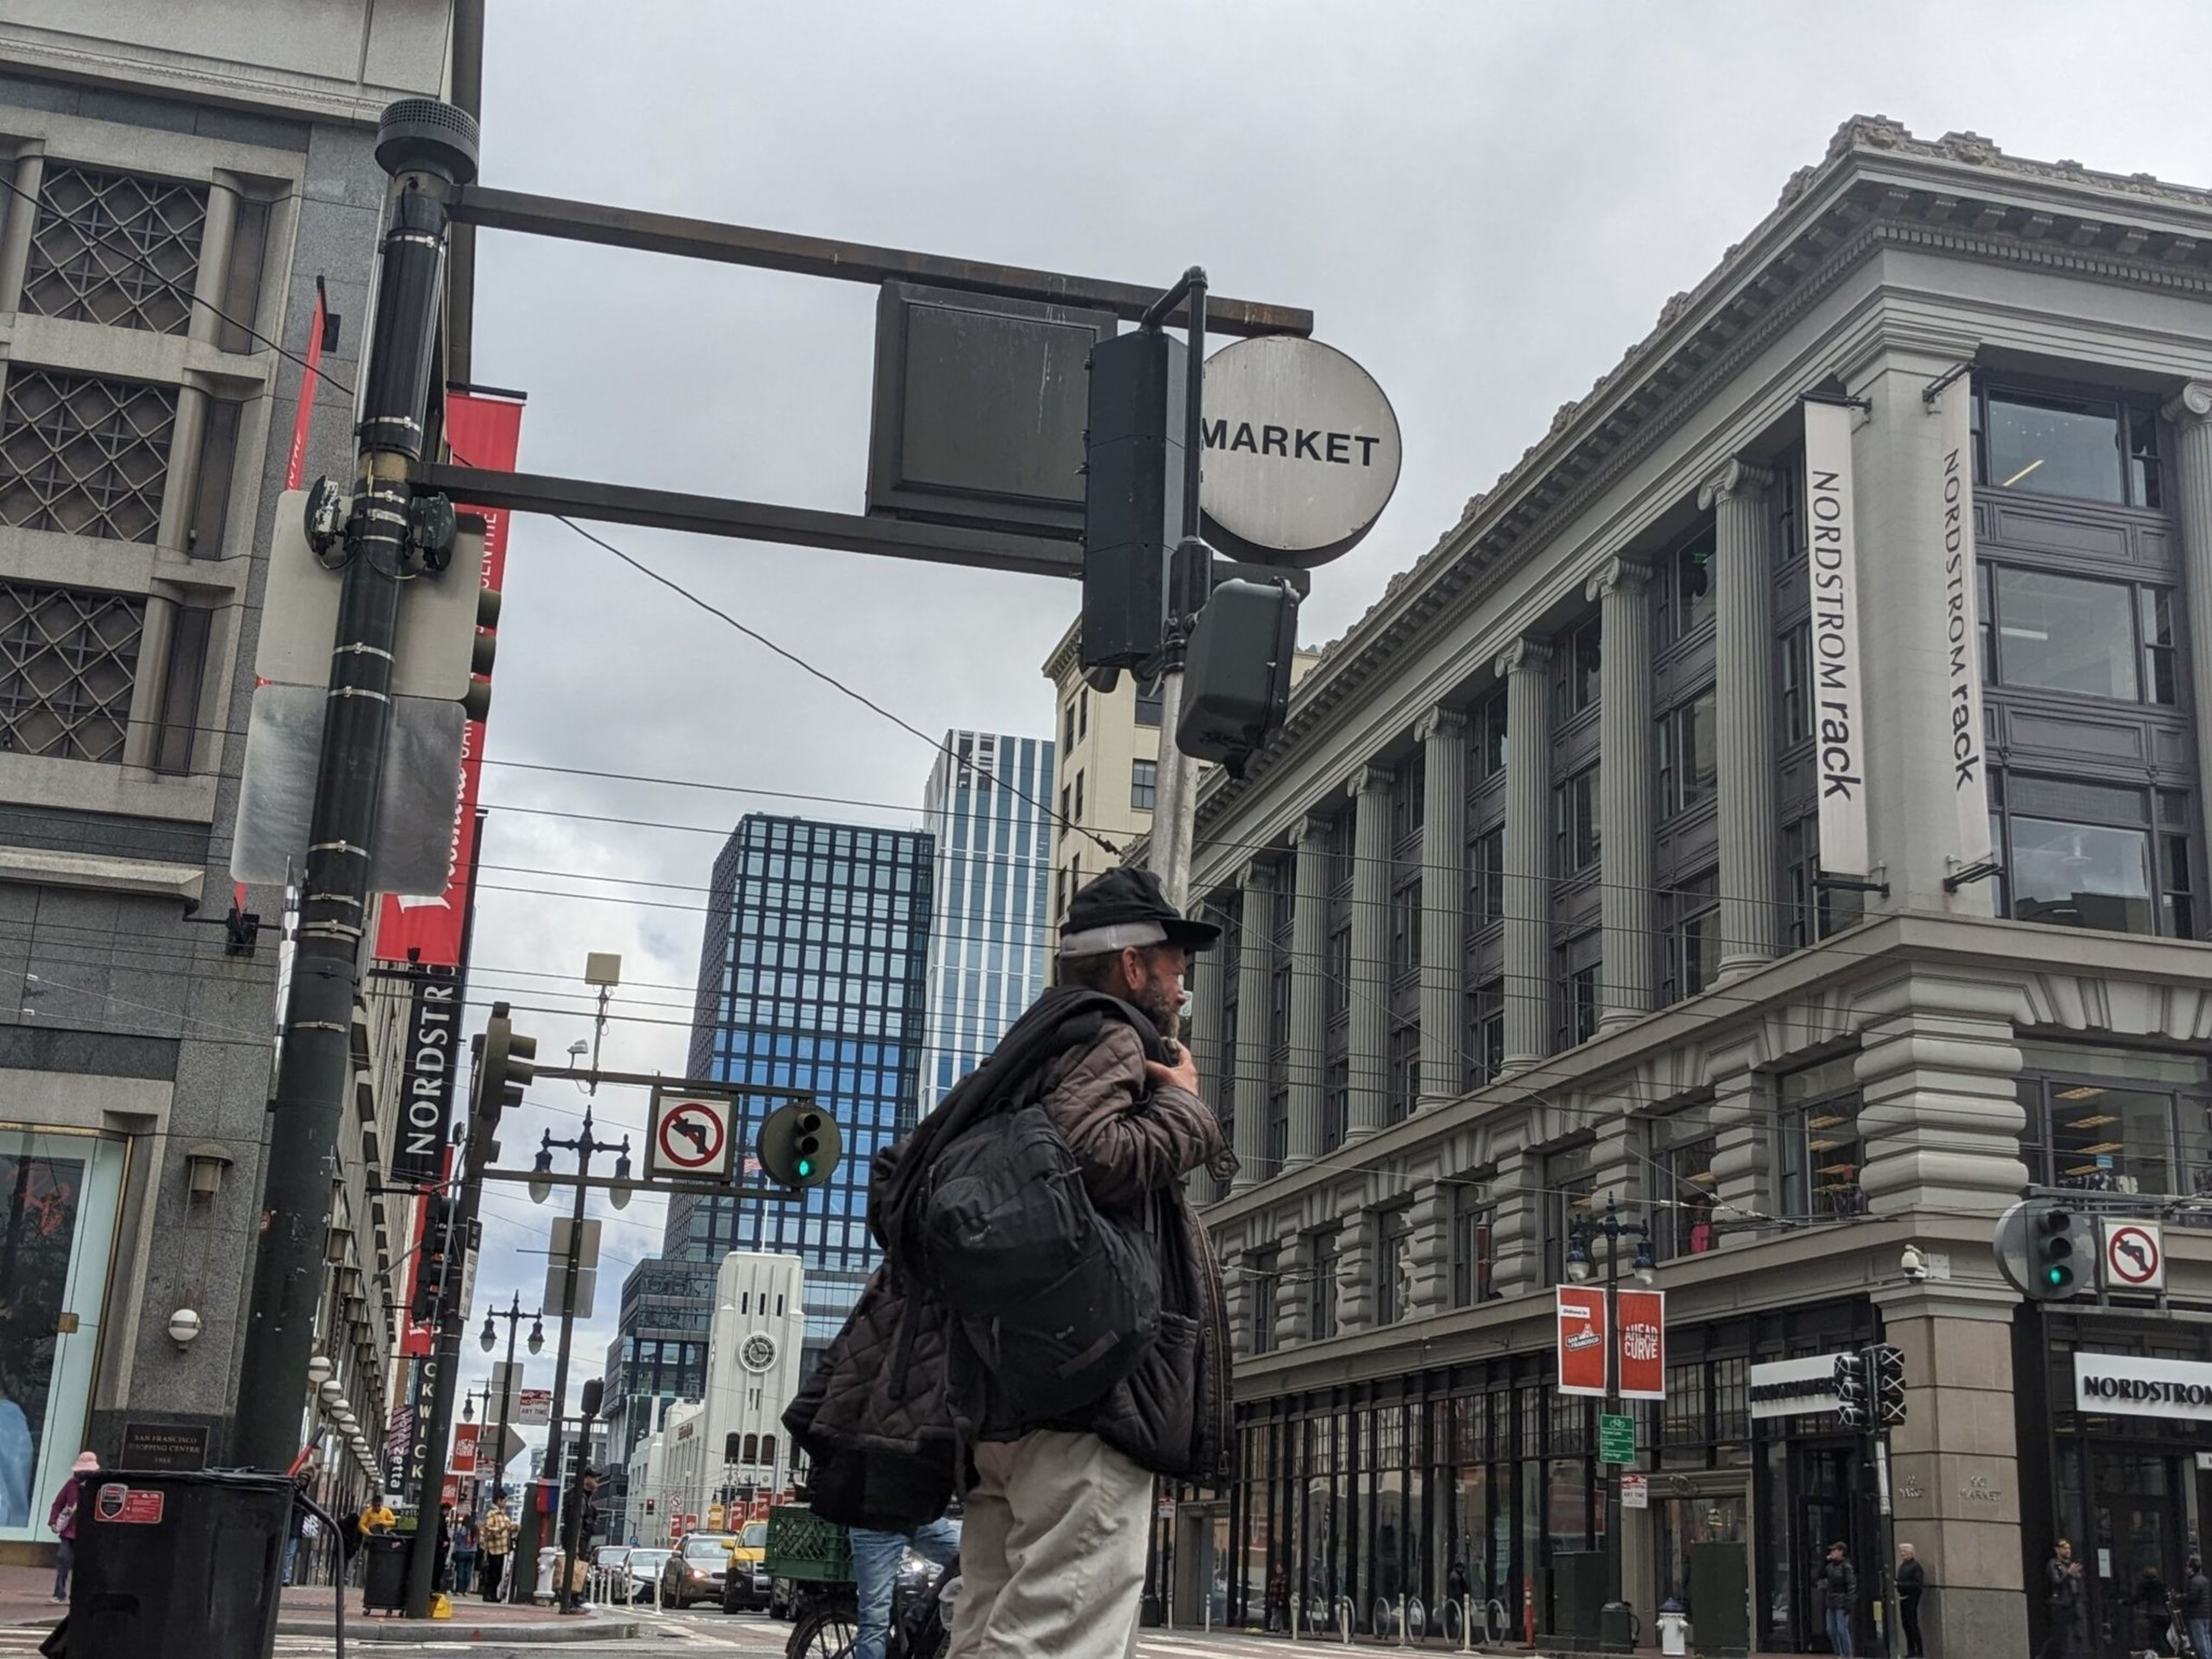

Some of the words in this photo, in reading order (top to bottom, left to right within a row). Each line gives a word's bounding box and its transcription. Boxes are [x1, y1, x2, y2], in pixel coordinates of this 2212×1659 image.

[1202, 418, 1380, 467] MARKET
[1812, 471, 1846, 689] NORDSTROM
[1943, 448, 1965, 677] NORDSTROM
[1821, 701, 1861, 801] rack
[1952, 685, 1979, 791] rack
[1625, 1323, 1658, 1342] AHEAD
[1625, 1338, 1658, 1360] CURVE
[390, 1446, 404, 1488] zetta
